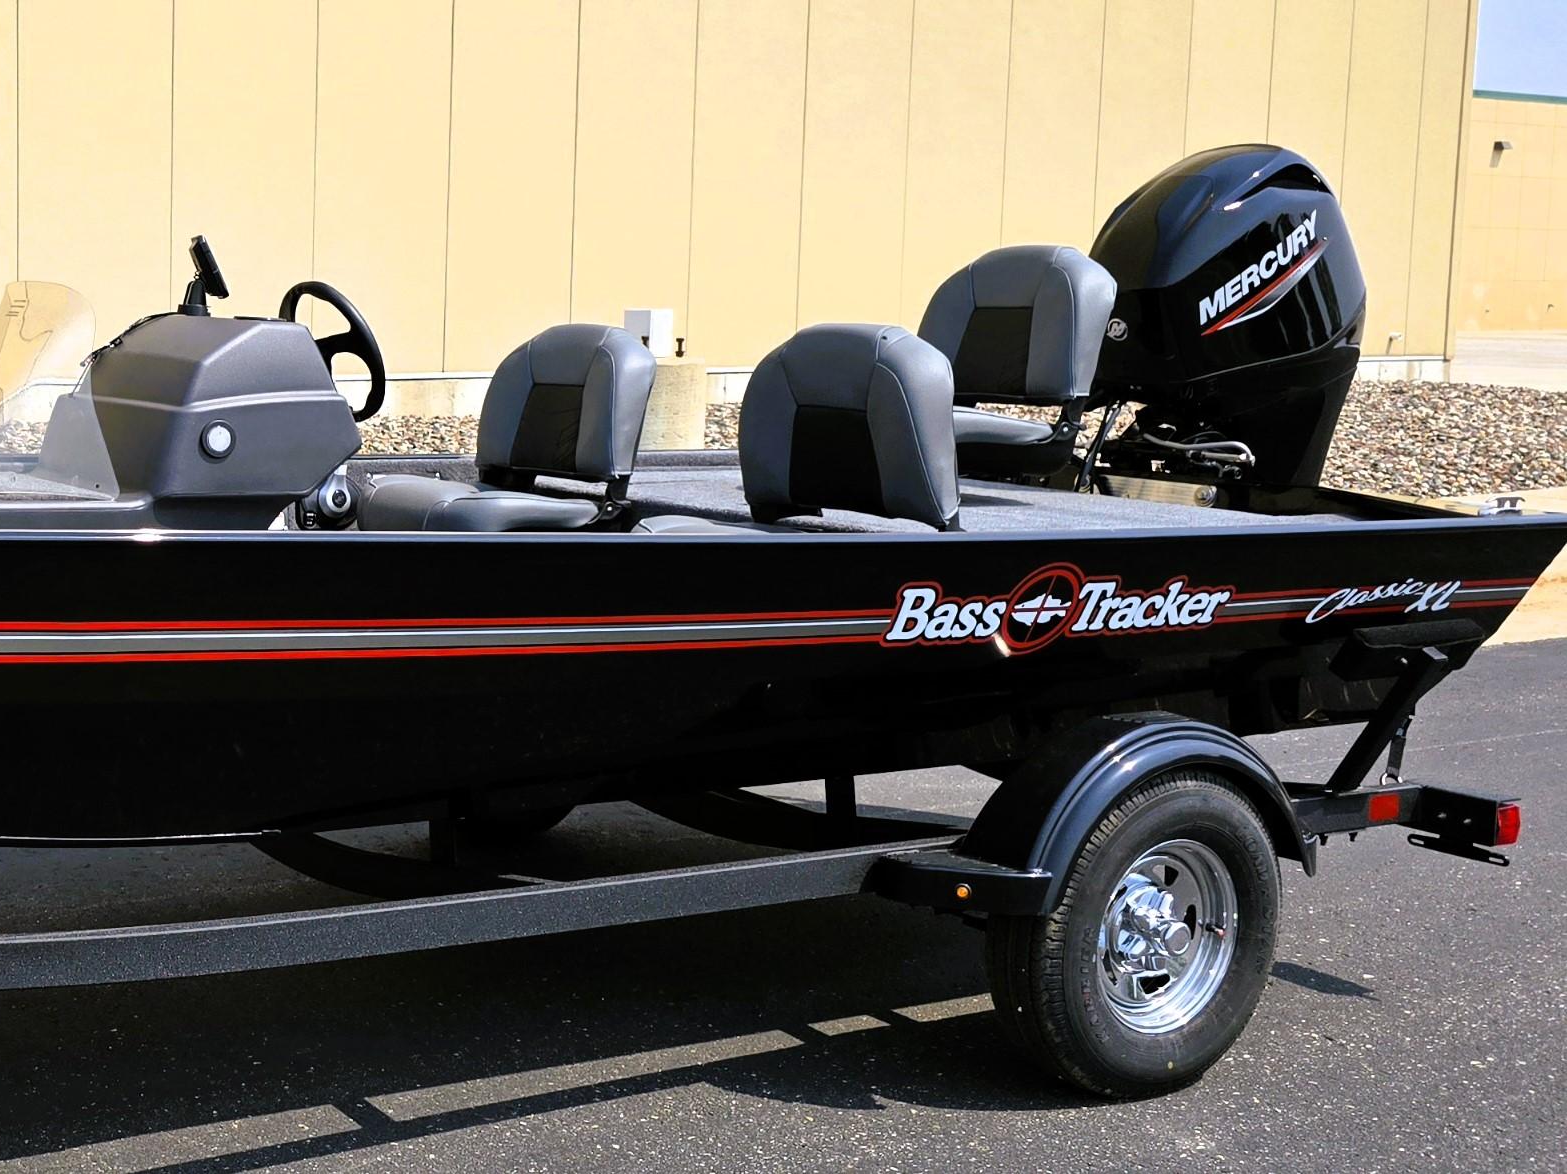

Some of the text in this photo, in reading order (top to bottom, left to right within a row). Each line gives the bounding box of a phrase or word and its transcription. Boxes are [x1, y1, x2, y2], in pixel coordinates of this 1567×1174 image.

[1199, 208, 1317, 326] MERCURY
[885, 581, 1230, 640] Bass Tracker
[1305, 578, 1461, 624] Classic XL
